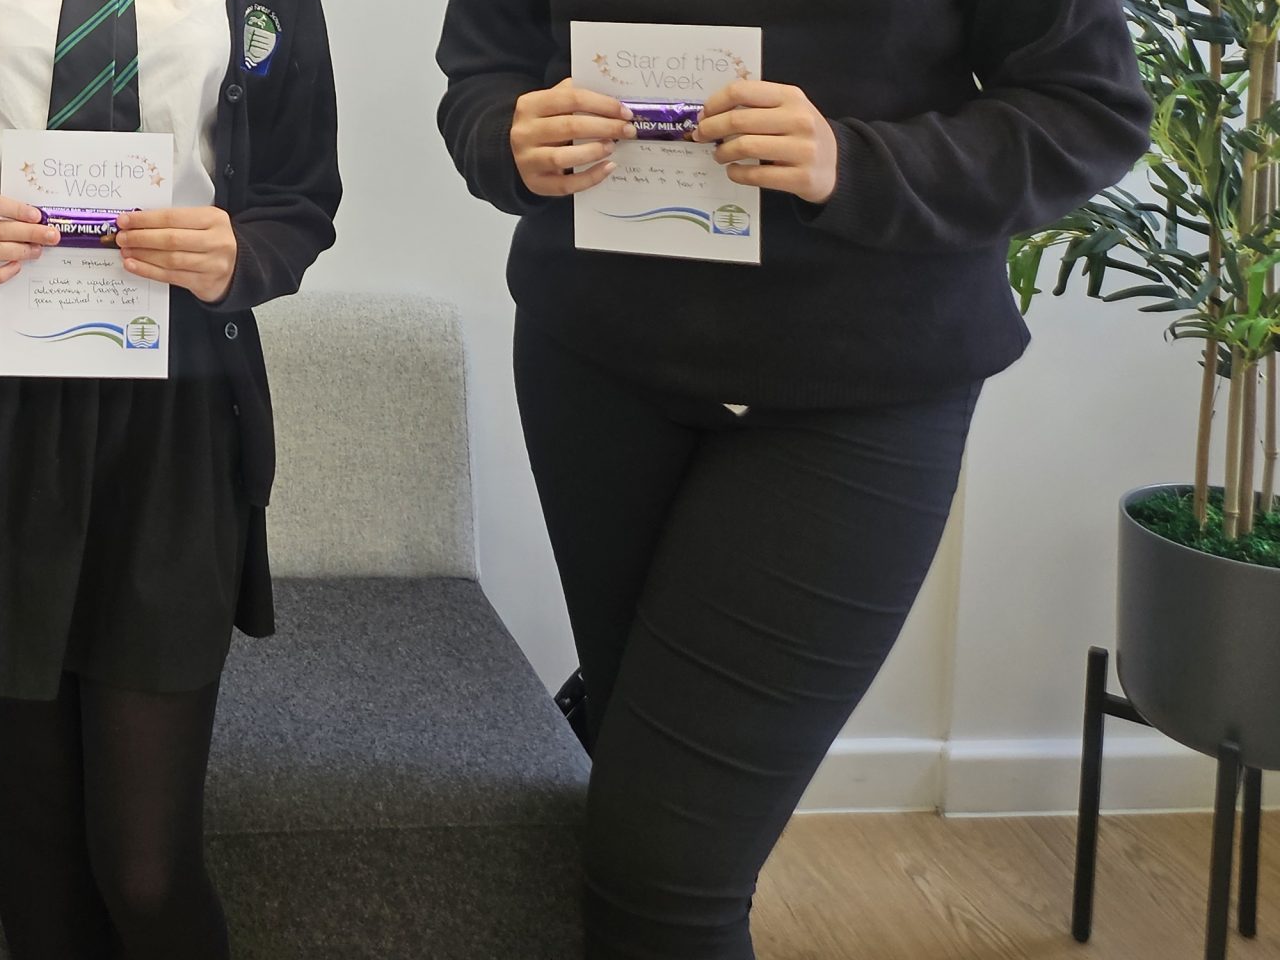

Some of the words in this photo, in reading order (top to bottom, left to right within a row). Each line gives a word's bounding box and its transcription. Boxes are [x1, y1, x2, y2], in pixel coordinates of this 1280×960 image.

[616, 50, 660, 69] Star
[666, 51, 689, 70] of
[695, 53, 729, 72] the
[640, 71, 704, 90] Week
[633, 121, 657, 130] AIRY
[658, 122, 683, 131] MILK
[42, 159, 82, 177] Star
[89, 159, 110, 178] of
[115, 160, 144, 179] the
[64, 179, 122, 198] Week
[47, 223, 76, 234] DAIRY
[78, 224, 102, 234] MILK
